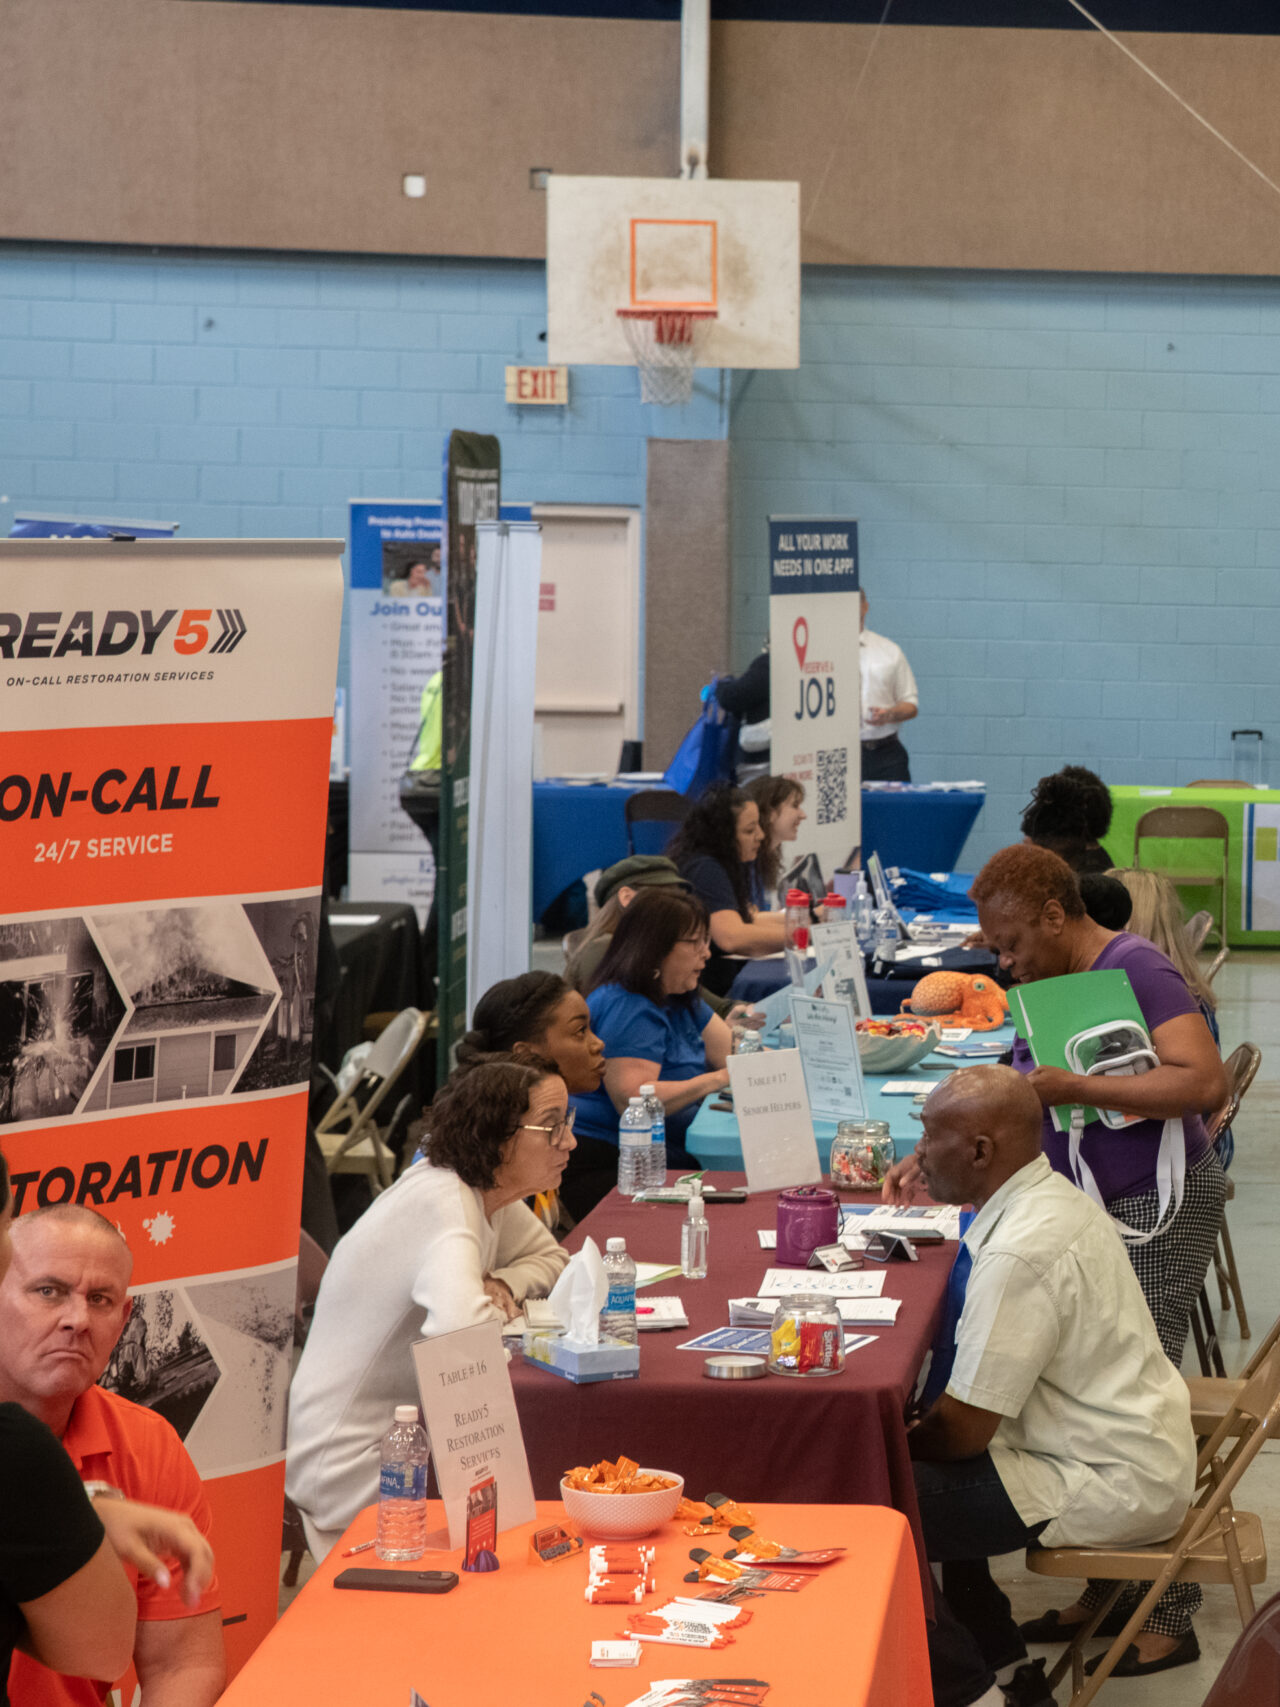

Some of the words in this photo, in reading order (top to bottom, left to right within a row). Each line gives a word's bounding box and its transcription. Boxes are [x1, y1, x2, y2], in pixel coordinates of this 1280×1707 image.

[517, 369, 557, 399] EXIT
[778, 533, 795, 552] ALL
[796, 533, 821, 551] YOUR
[822, 533, 849, 551] WORK
[774, 558, 802, 577] NEEDS
[804, 558, 813, 576] IN
[814, 558, 833, 576] ONE
[834, 558, 854, 575] APP!
[370, 601, 410, 617] Join
[416, 601, 442, 617] Ou
[0, 608, 213, 659] READY5
[6, 675, 62, 687] ON-CALL
[66, 672, 151, 685] RESTORATION
[153, 671, 215, 682] SERVICES
[795, 677, 836, 721] JOB
[0, 764, 220, 822] ON-CALL
[34, 838, 81, 863] 24/7
[86, 833, 174, 858] SERVICE
[778, 1072, 787, 1083] 17
[9, 1137, 270, 1220] TORATION
[438, 1368, 469, 1387] TABLE
[476, 1359, 488, 1376] 16
[453, 1403, 490, 1428] READY5
[446, 1422, 506, 1453] RESTORATION
[460, 1447, 501, 1471] SERVICES
